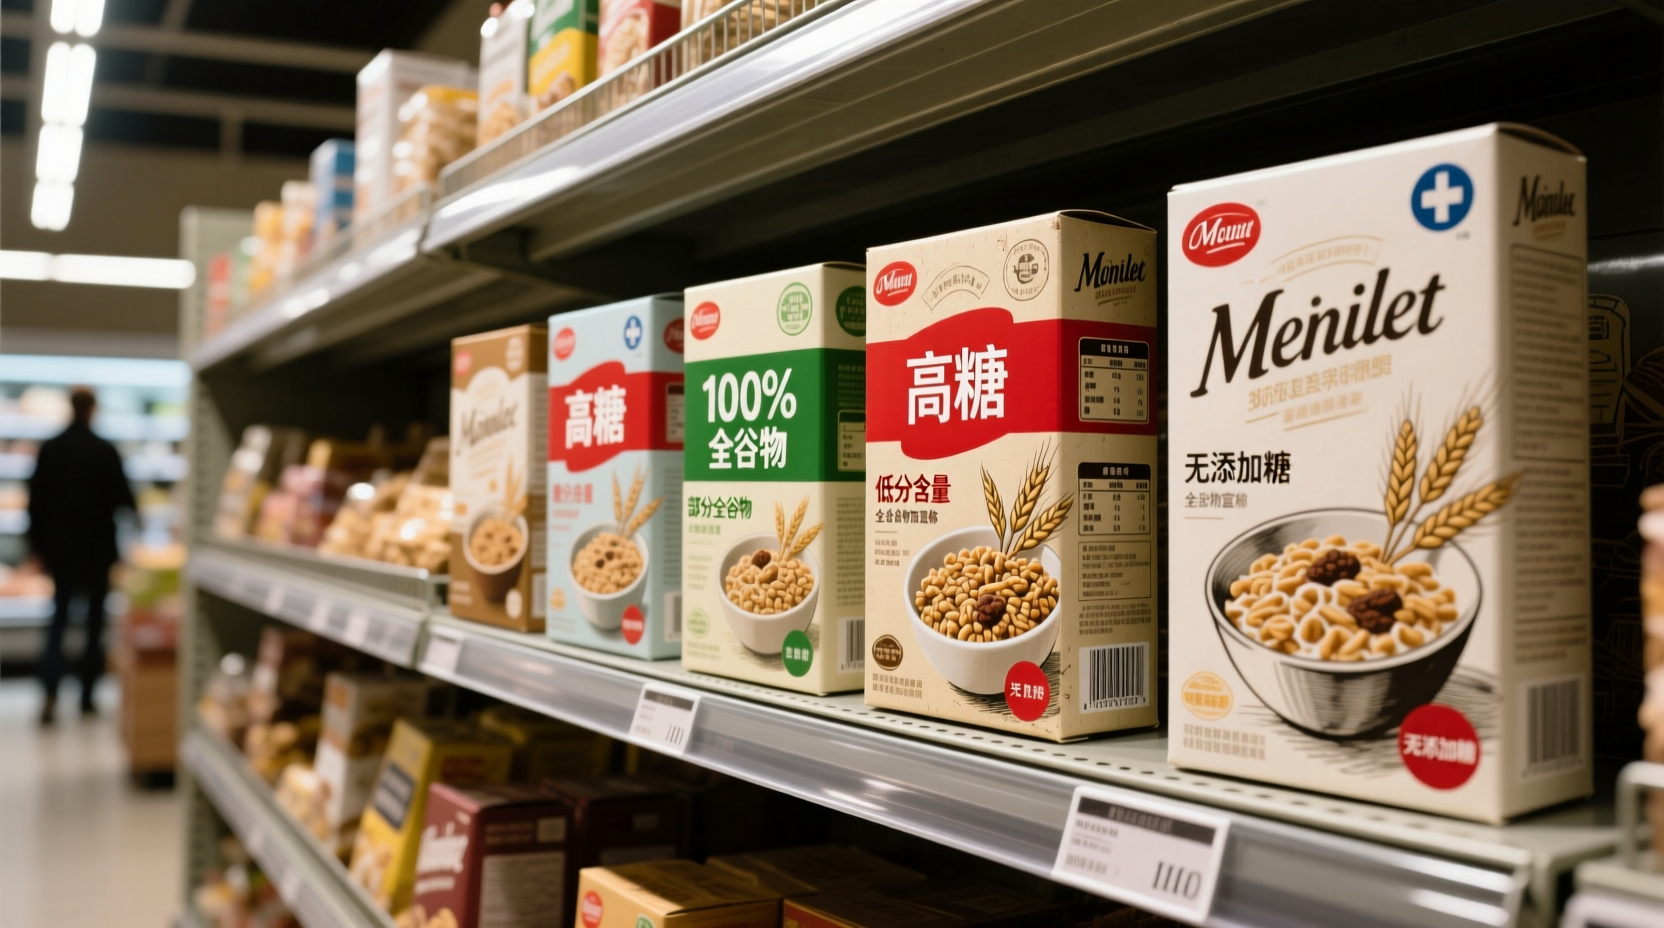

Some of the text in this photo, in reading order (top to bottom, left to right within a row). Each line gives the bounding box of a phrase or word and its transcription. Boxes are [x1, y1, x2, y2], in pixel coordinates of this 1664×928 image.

[702, 368, 797, 423] 100%
[906, 344, 1009, 425] 高糖
[565, 384, 627, 449] 高糖
[708, 426, 788, 469] 全谷物
[1185, 450, 1292, 484] 无添加糖
